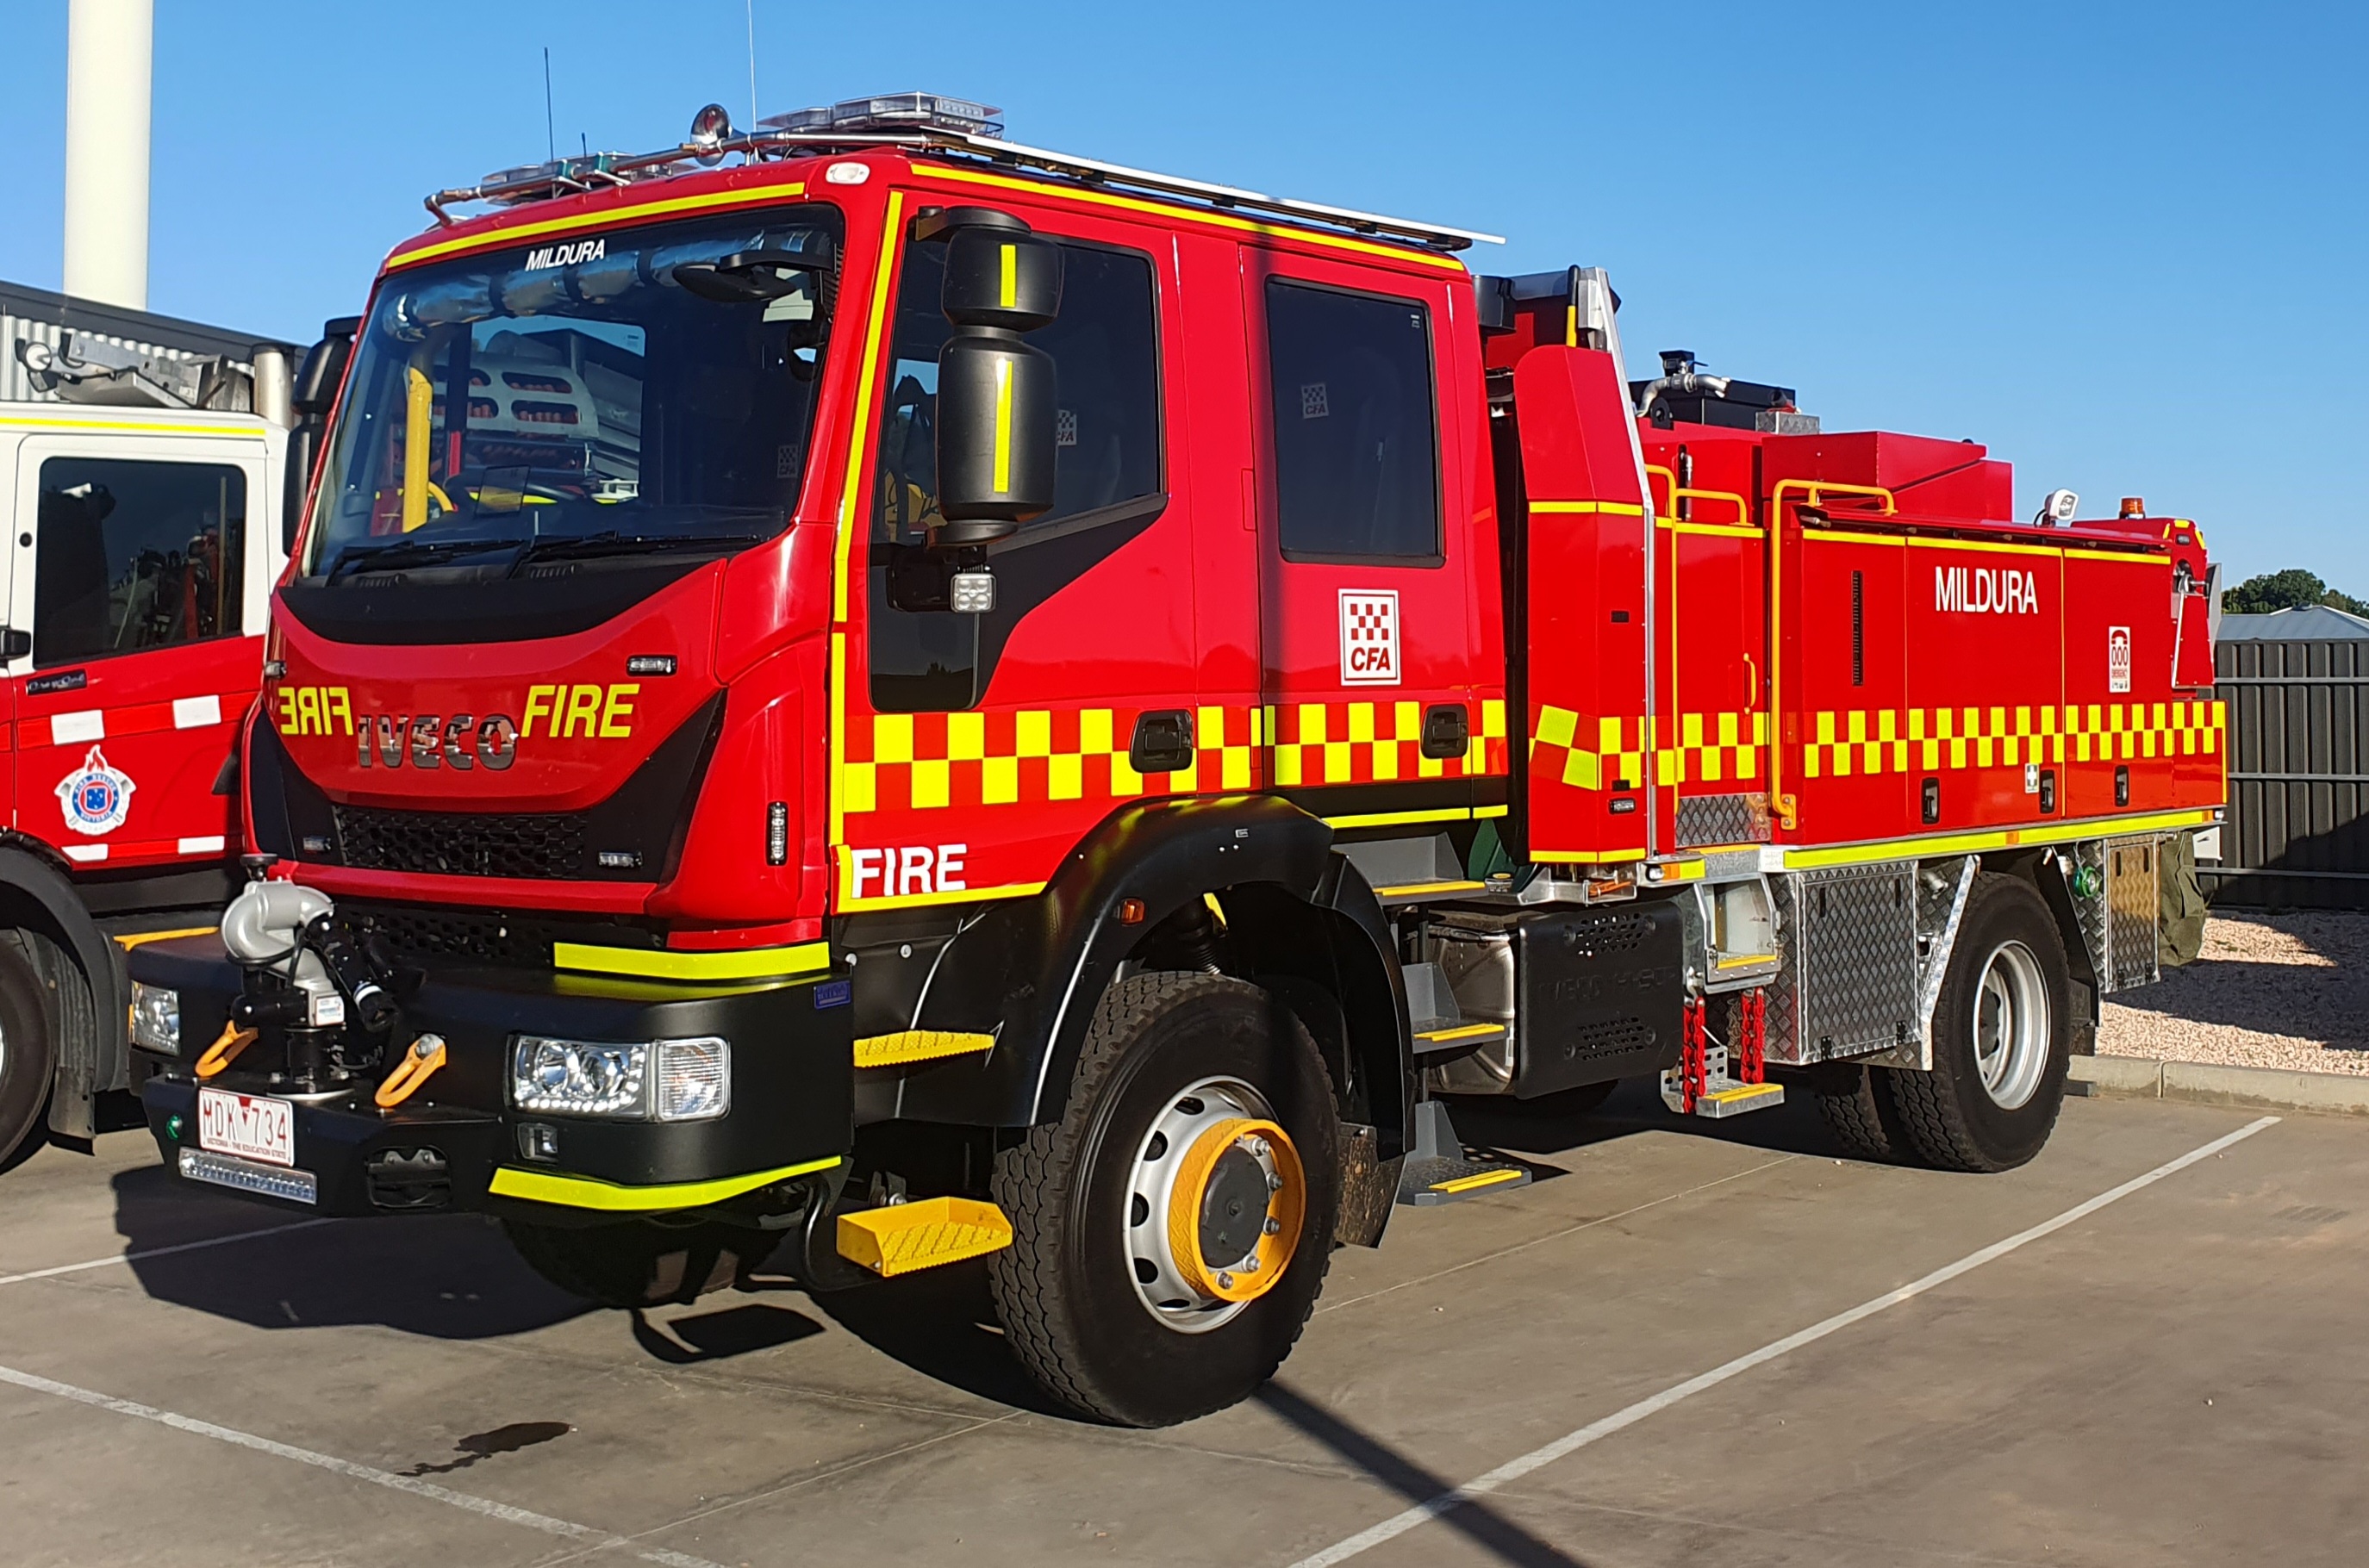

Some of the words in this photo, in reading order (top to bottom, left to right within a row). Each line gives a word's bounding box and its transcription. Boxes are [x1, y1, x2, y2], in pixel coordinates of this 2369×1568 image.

[525, 239, 605, 271] MILDURA
[1936, 566, 2039, 614] MILDURA
[1350, 647, 1391, 671] CFA
[2111, 645, 2129, 666] 000
[521, 684, 640, 738] FIRE
[358, 714, 517, 770] IVECO
[851, 843, 967, 899] FIRE
[203, 1097, 237, 1142] MDK
[252, 1107, 287, 1150] 734
[242, 1143, 271, 1156] EDUCATION
